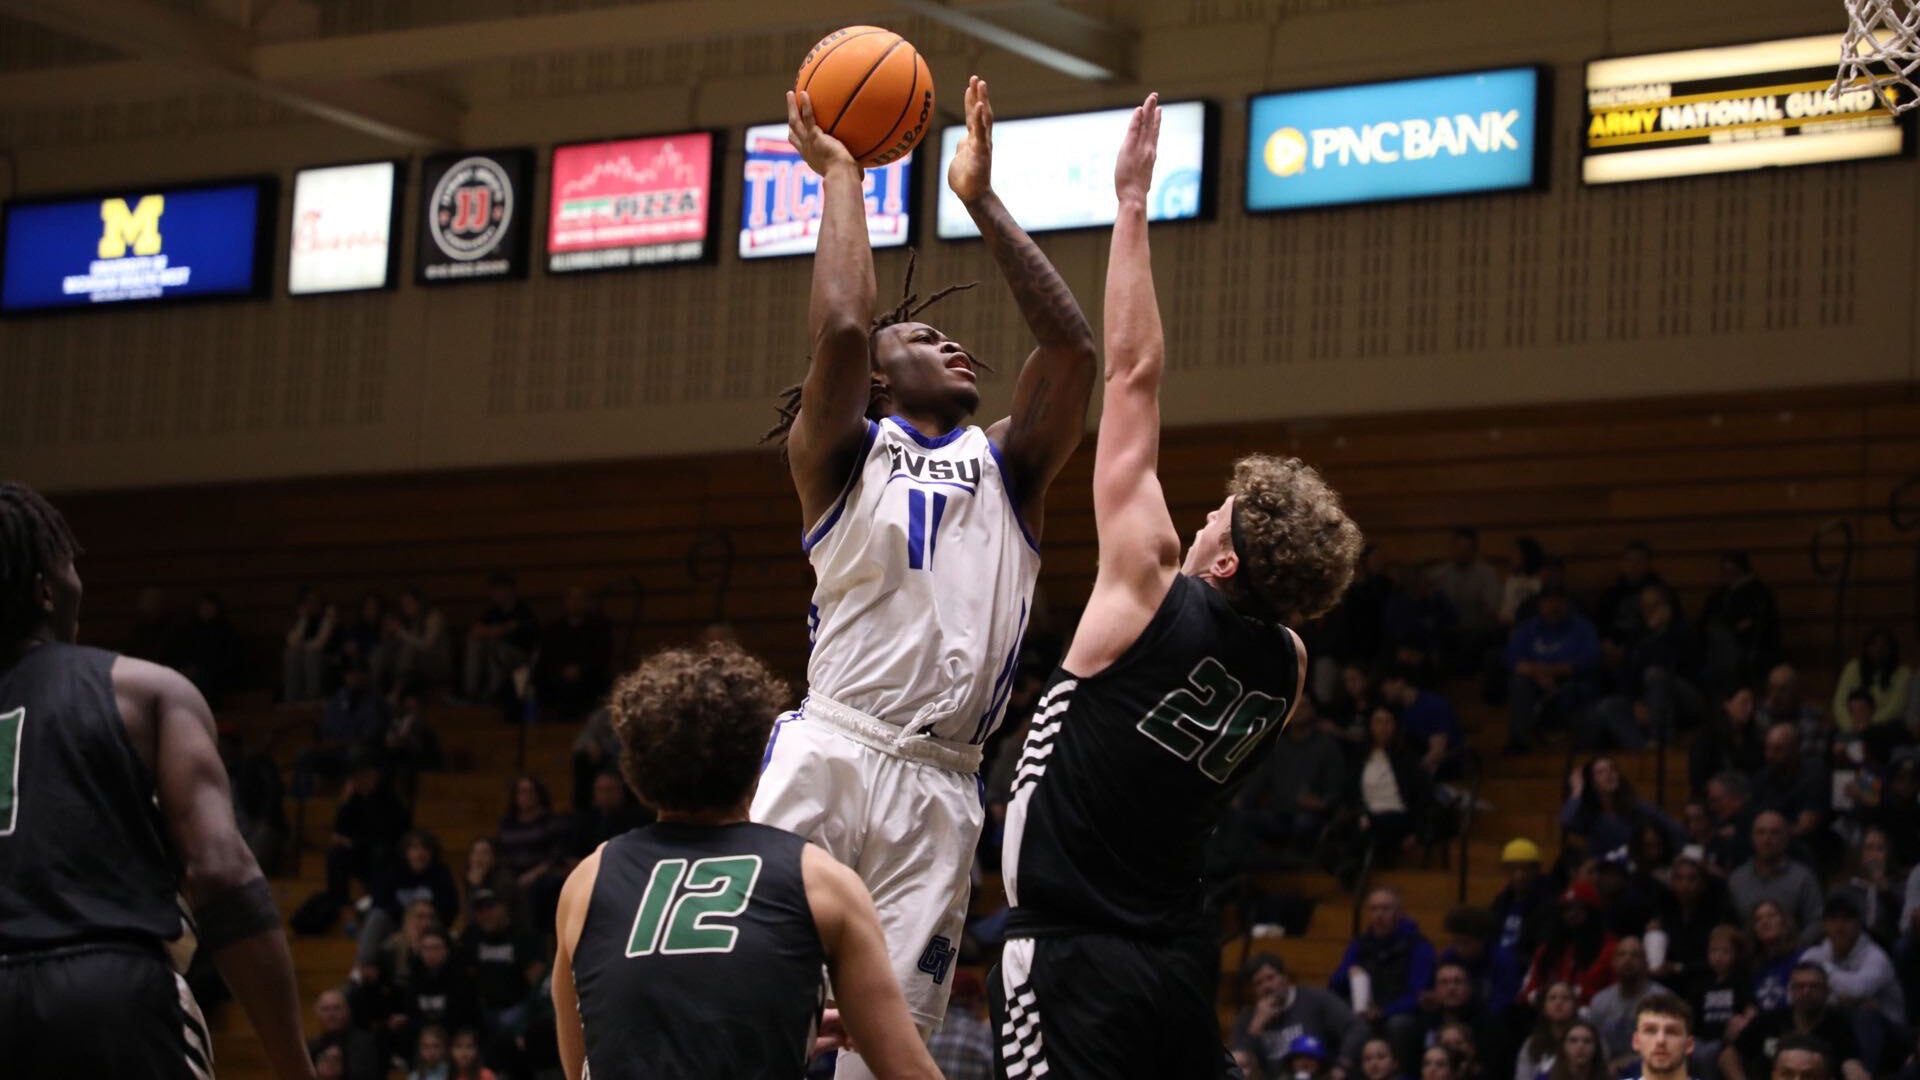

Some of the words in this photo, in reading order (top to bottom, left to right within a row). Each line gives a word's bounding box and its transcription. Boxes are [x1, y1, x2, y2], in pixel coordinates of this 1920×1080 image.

[1588, 107, 1660, 138] ARMY
[1661, 94, 1783, 131] NATIONAL
[1785, 89, 1875, 119] GUARD
[452, 185, 492, 235] JJ
[613, 190, 698, 220] PIZZA
[744, 157, 911, 228] TICT
[98, 194, 165, 260] M
[907, 487, 948, 573] 11
[1136, 656, 1287, 784] 20
[624, 854, 763, 959] 12
